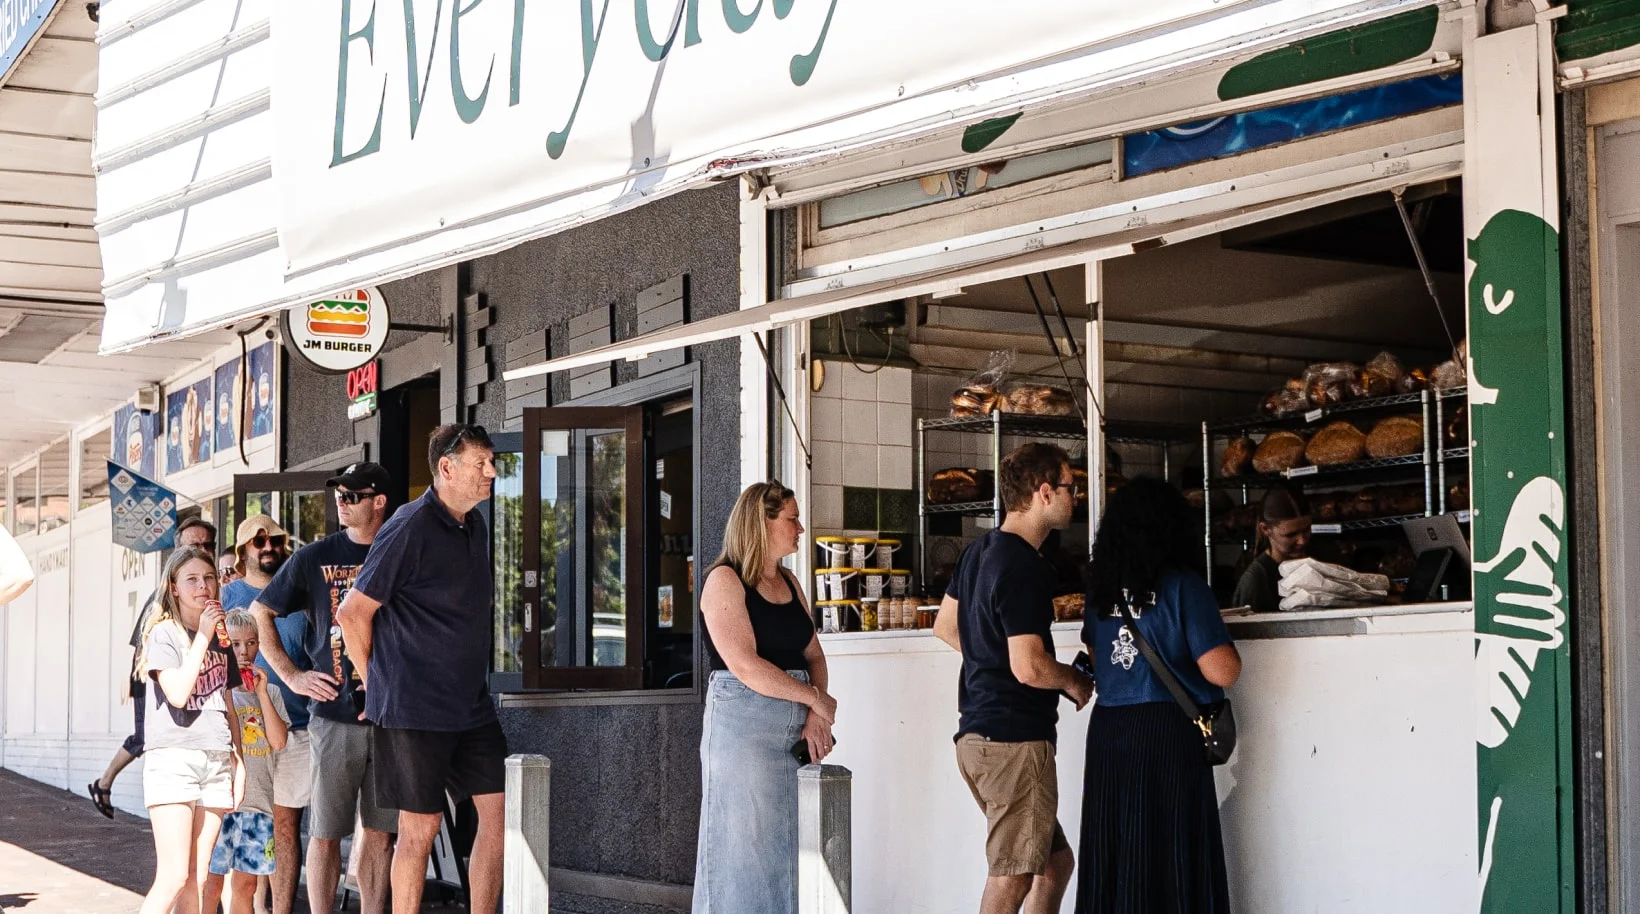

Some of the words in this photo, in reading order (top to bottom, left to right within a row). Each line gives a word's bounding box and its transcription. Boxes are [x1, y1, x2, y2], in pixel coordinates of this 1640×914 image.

[331, 0, 838, 167] Every
[303, 339, 321, 350] JM
[324, 341, 372, 353] BURGER
[346, 361, 377, 401] OPEN
[121, 548, 146, 582] OPEN
